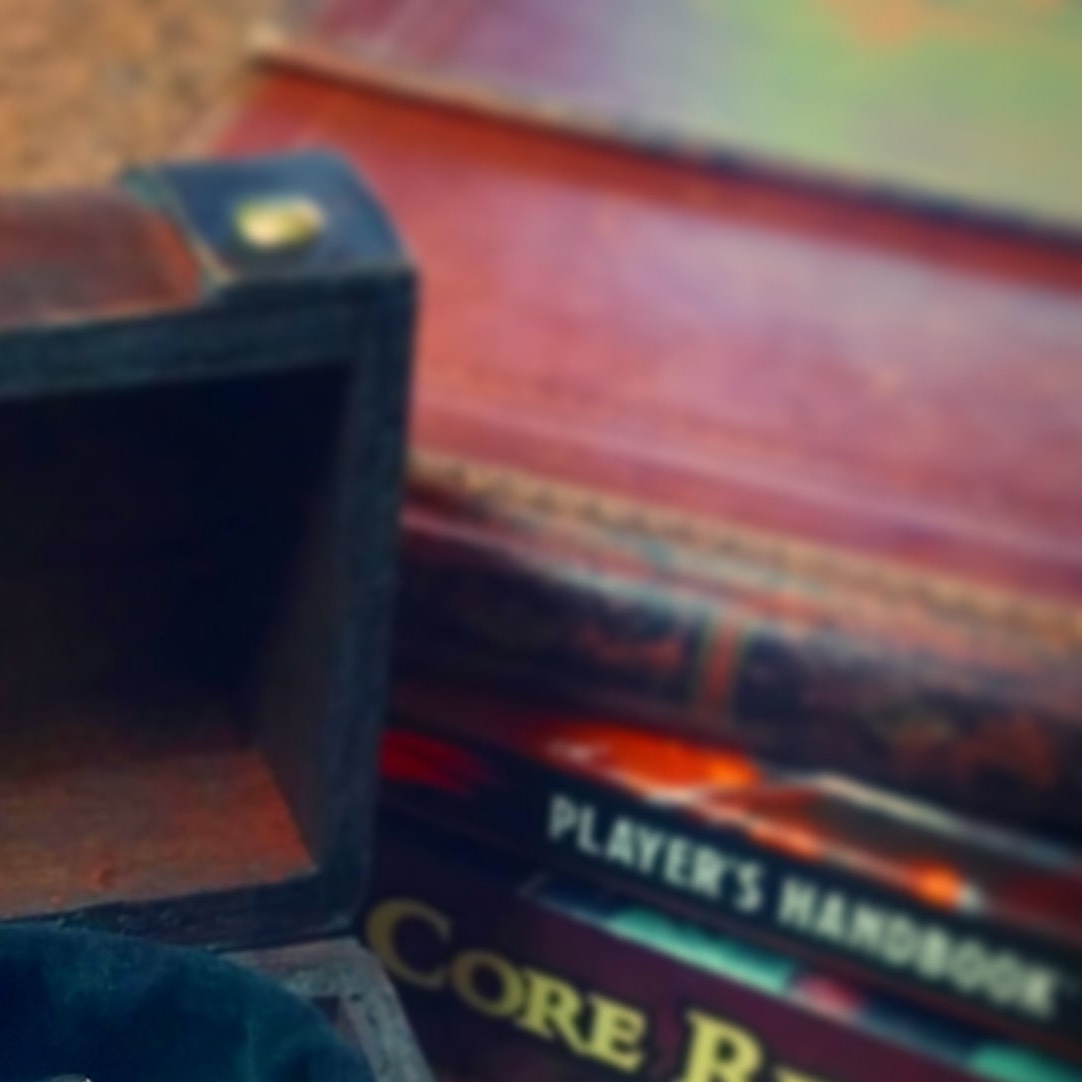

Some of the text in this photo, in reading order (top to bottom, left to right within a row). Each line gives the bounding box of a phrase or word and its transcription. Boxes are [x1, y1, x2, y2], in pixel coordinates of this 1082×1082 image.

[364, 897, 647, 1073] CORE
[547, 795, 1064, 1022] PLAYER'S HANDBOOK
